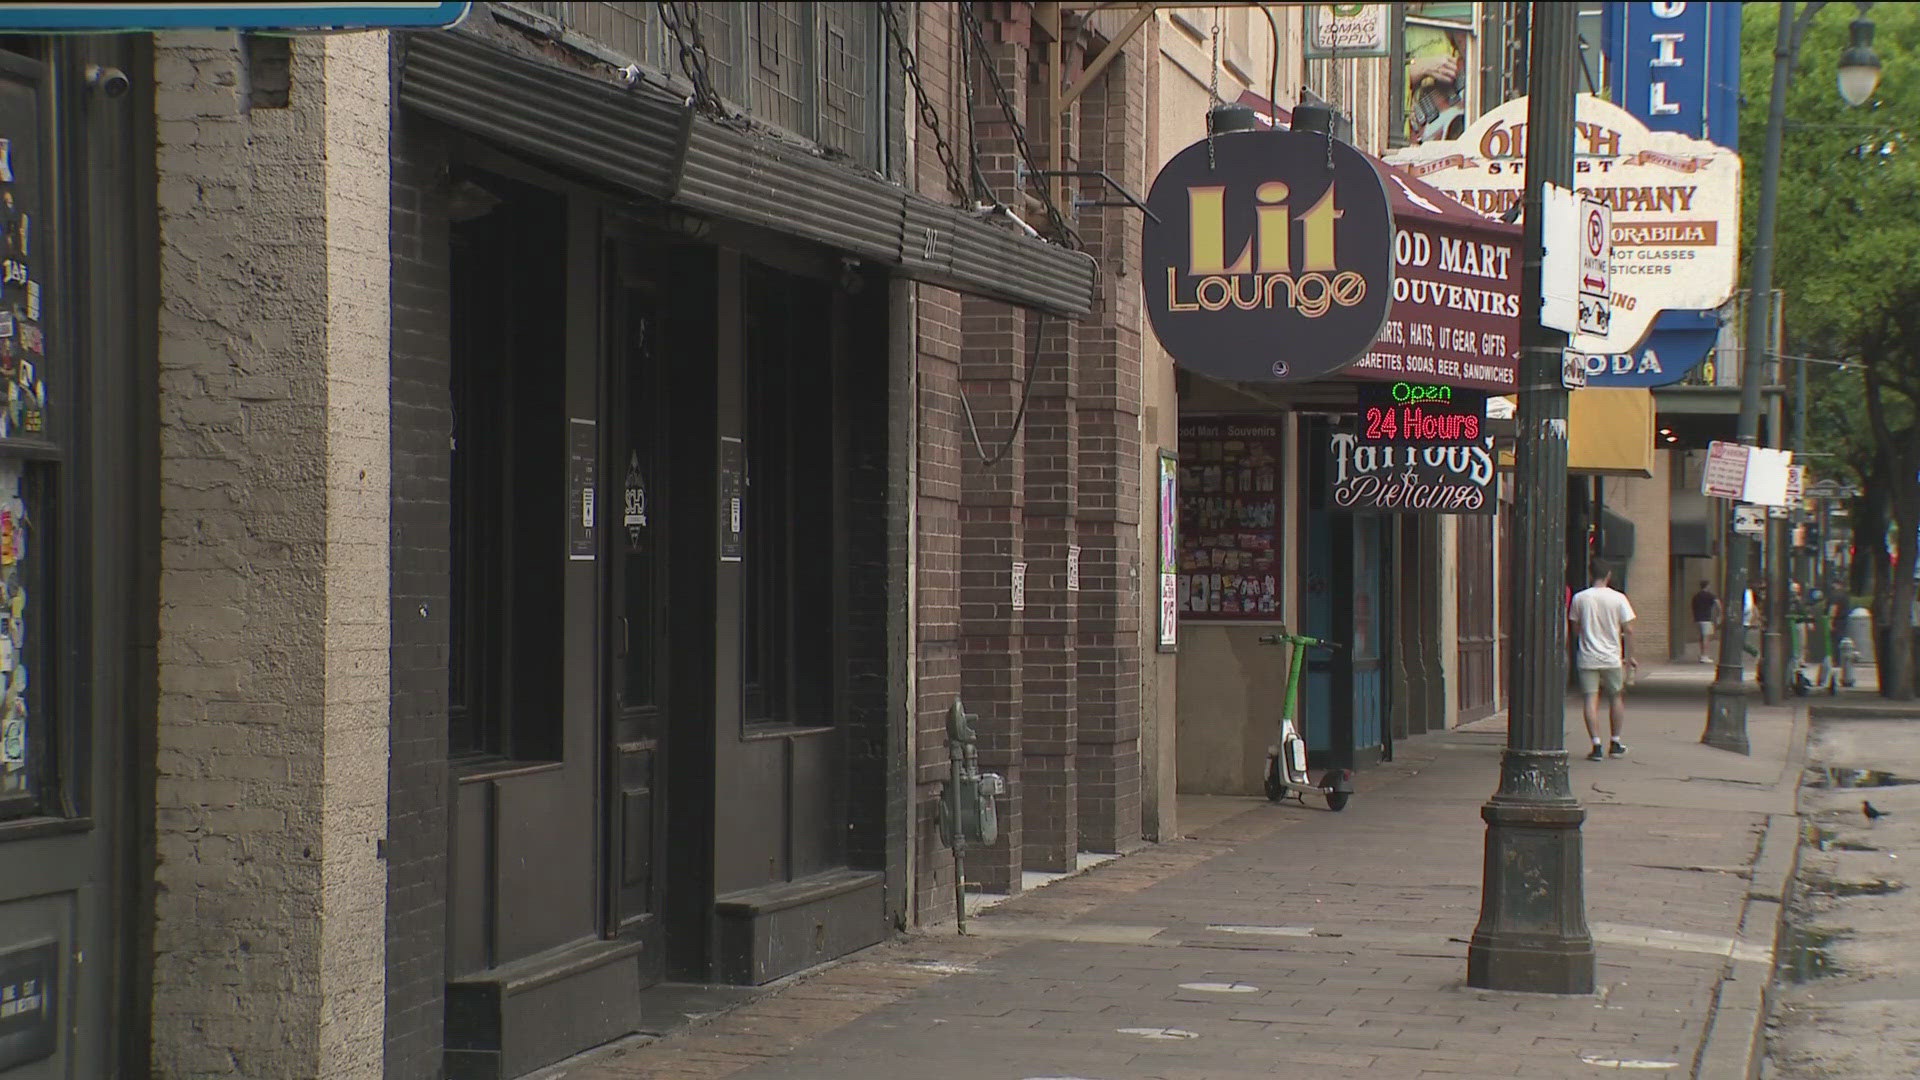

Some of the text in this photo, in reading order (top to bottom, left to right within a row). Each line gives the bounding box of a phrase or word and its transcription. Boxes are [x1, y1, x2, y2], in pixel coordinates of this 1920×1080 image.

[1419, 160, 1451, 174] GIFTS
[1488, 161, 1613, 174] STET
[1187, 180, 1345, 276] Lit
[1611, 227, 1706, 244] ORABILIA
[1395, 230, 1511, 281] OD MART
[1584, 256, 1606, 274] ANYTIME
[1637, 250, 1695, 260] GLASSES
[1610, 265, 1672, 275] STICKERS
[1167, 266, 1367, 318] Lounge
[1393, 277, 1520, 318] OUVENIRS
[1610, 290, 1637, 311] ING
[1439, 326, 1451, 350] UT
[1482, 332, 1506, 358] GIFTS
[1463, 362, 1514, 384] SANDWICHES
[1585, 350, 1662, 376] ODA
[1392, 381, 1451, 405] Open
[1198, 426, 1219, 437] Mart
[1227, 425, 1276, 437] Souvenirs
[1366, 407, 1479, 440] 24 Hours
[1334, 473, 1484, 510] Piercings
